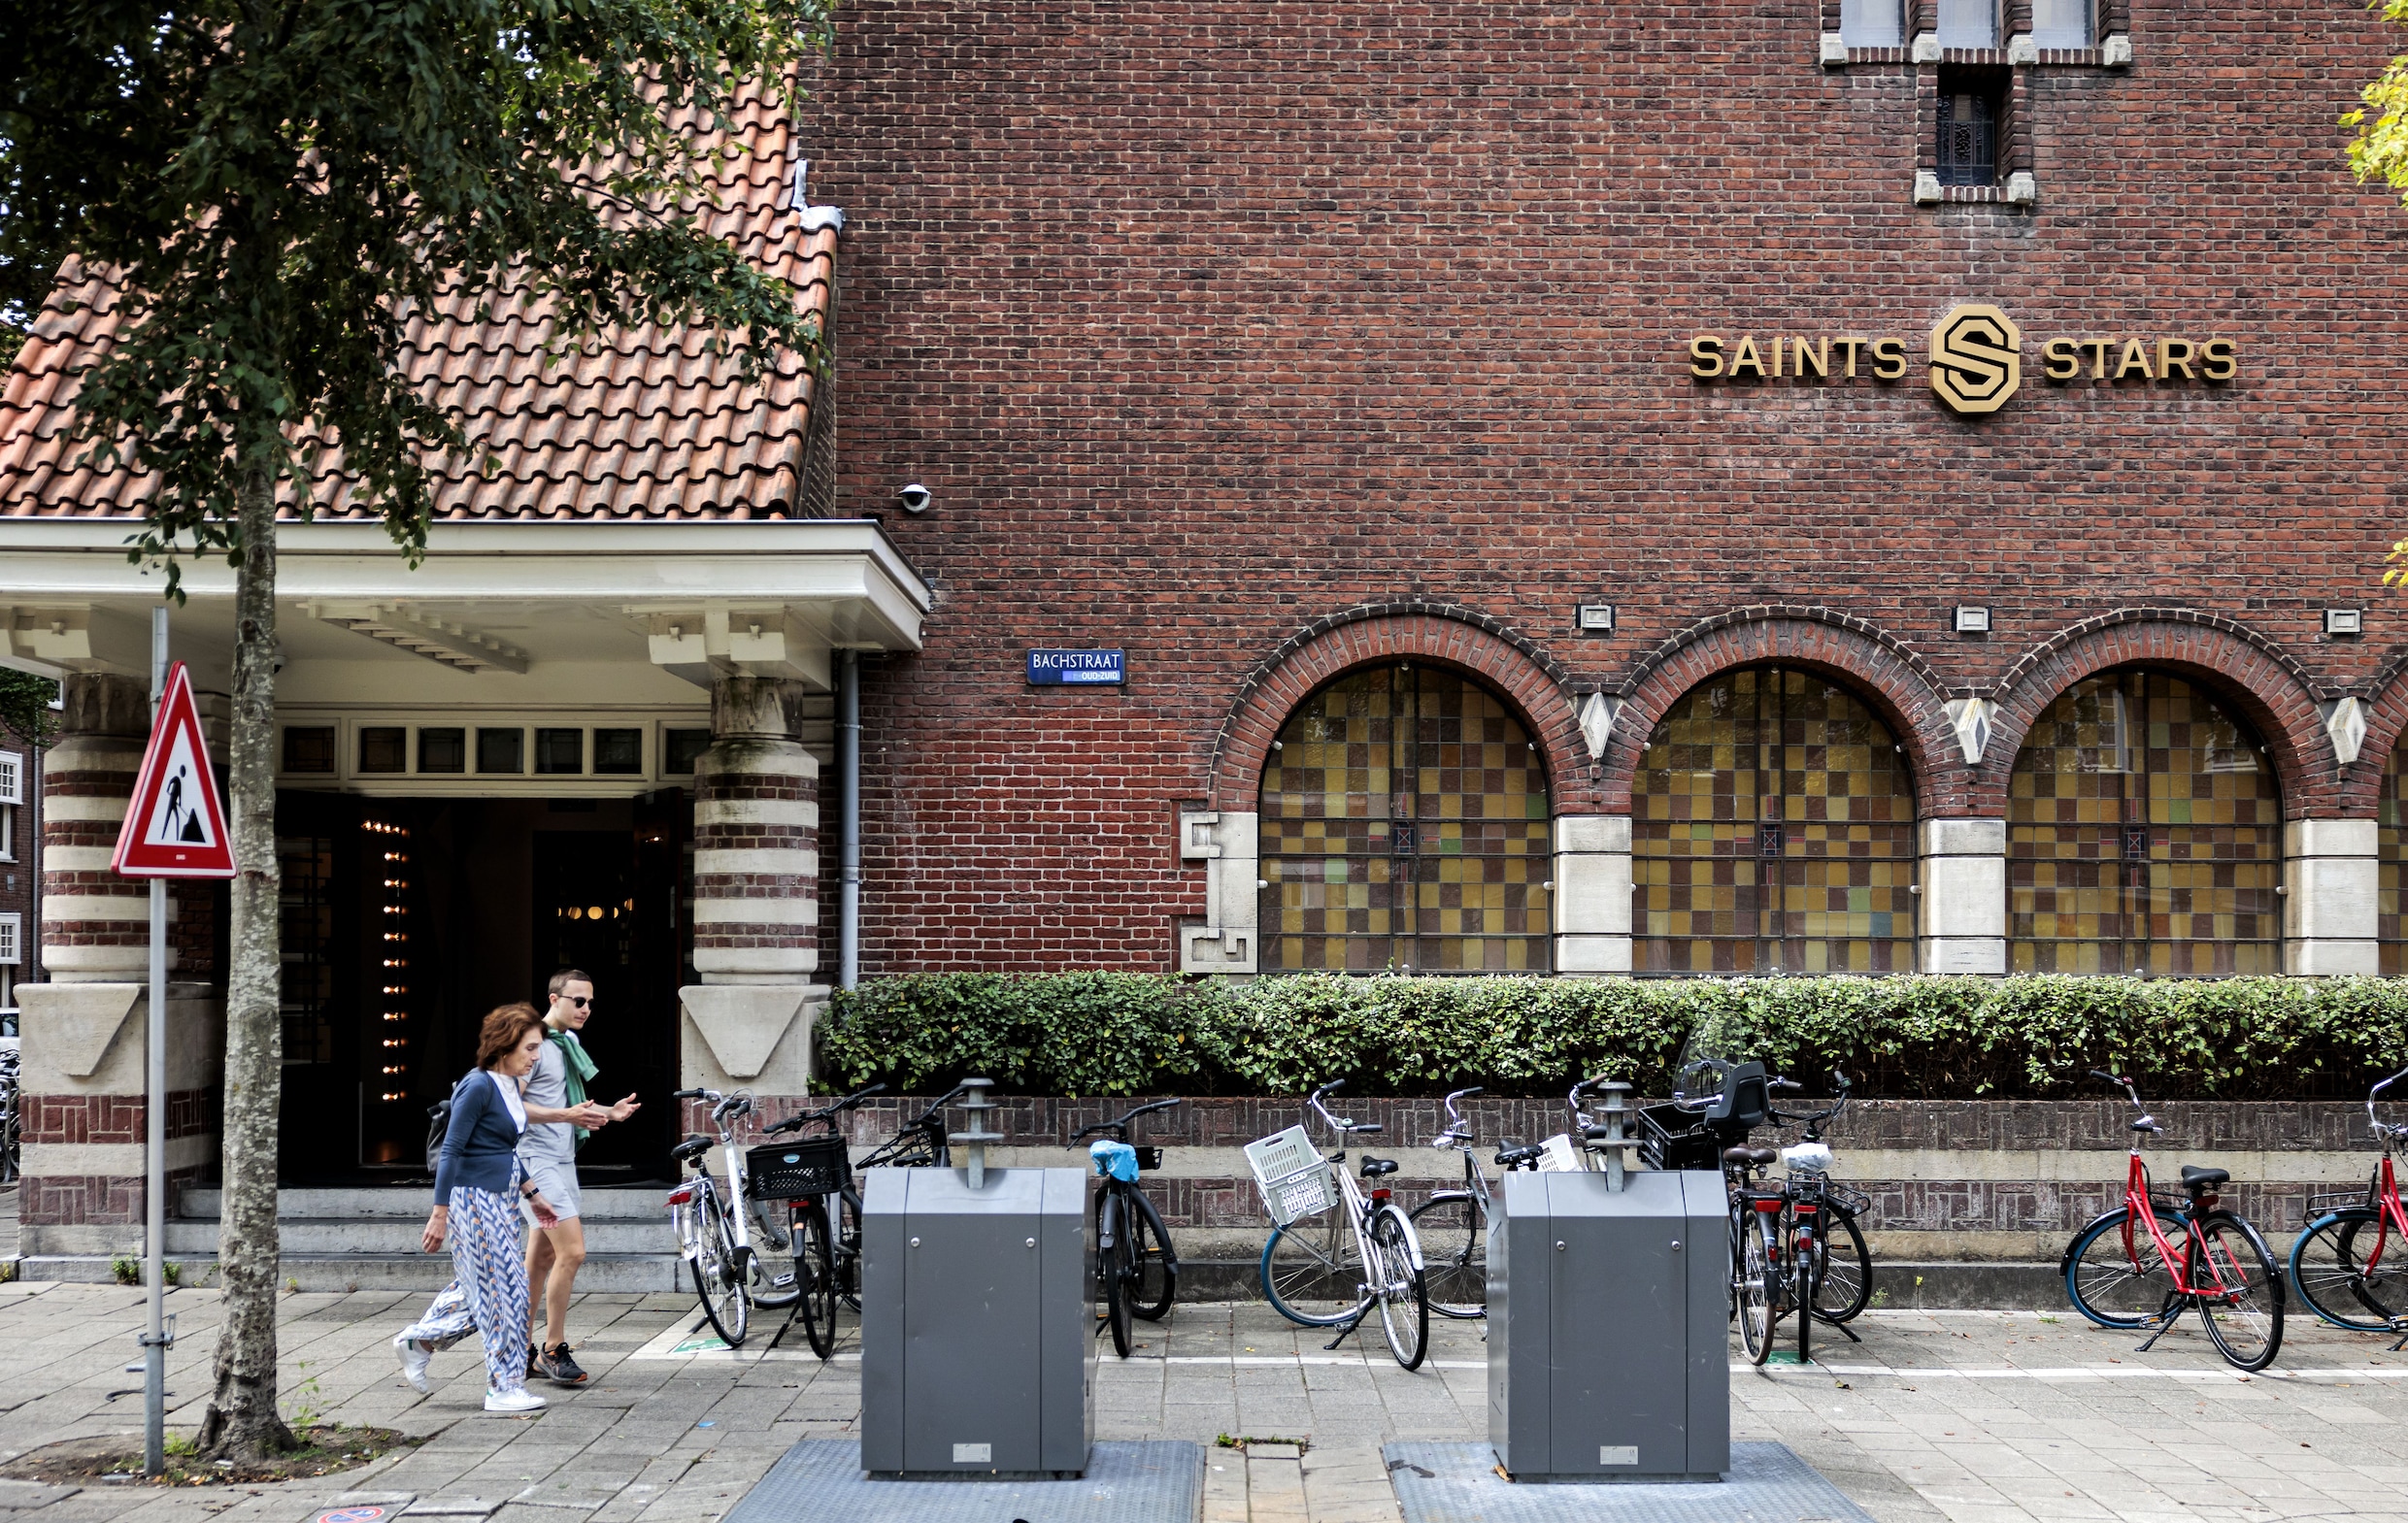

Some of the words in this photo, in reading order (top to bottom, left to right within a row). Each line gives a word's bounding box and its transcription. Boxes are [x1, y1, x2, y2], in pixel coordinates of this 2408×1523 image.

[1689, 336, 1907, 380] SAINTS
[2044, 337, 2237, 381] STARS
[1033, 653, 1120, 668] BACHSTRAAT
